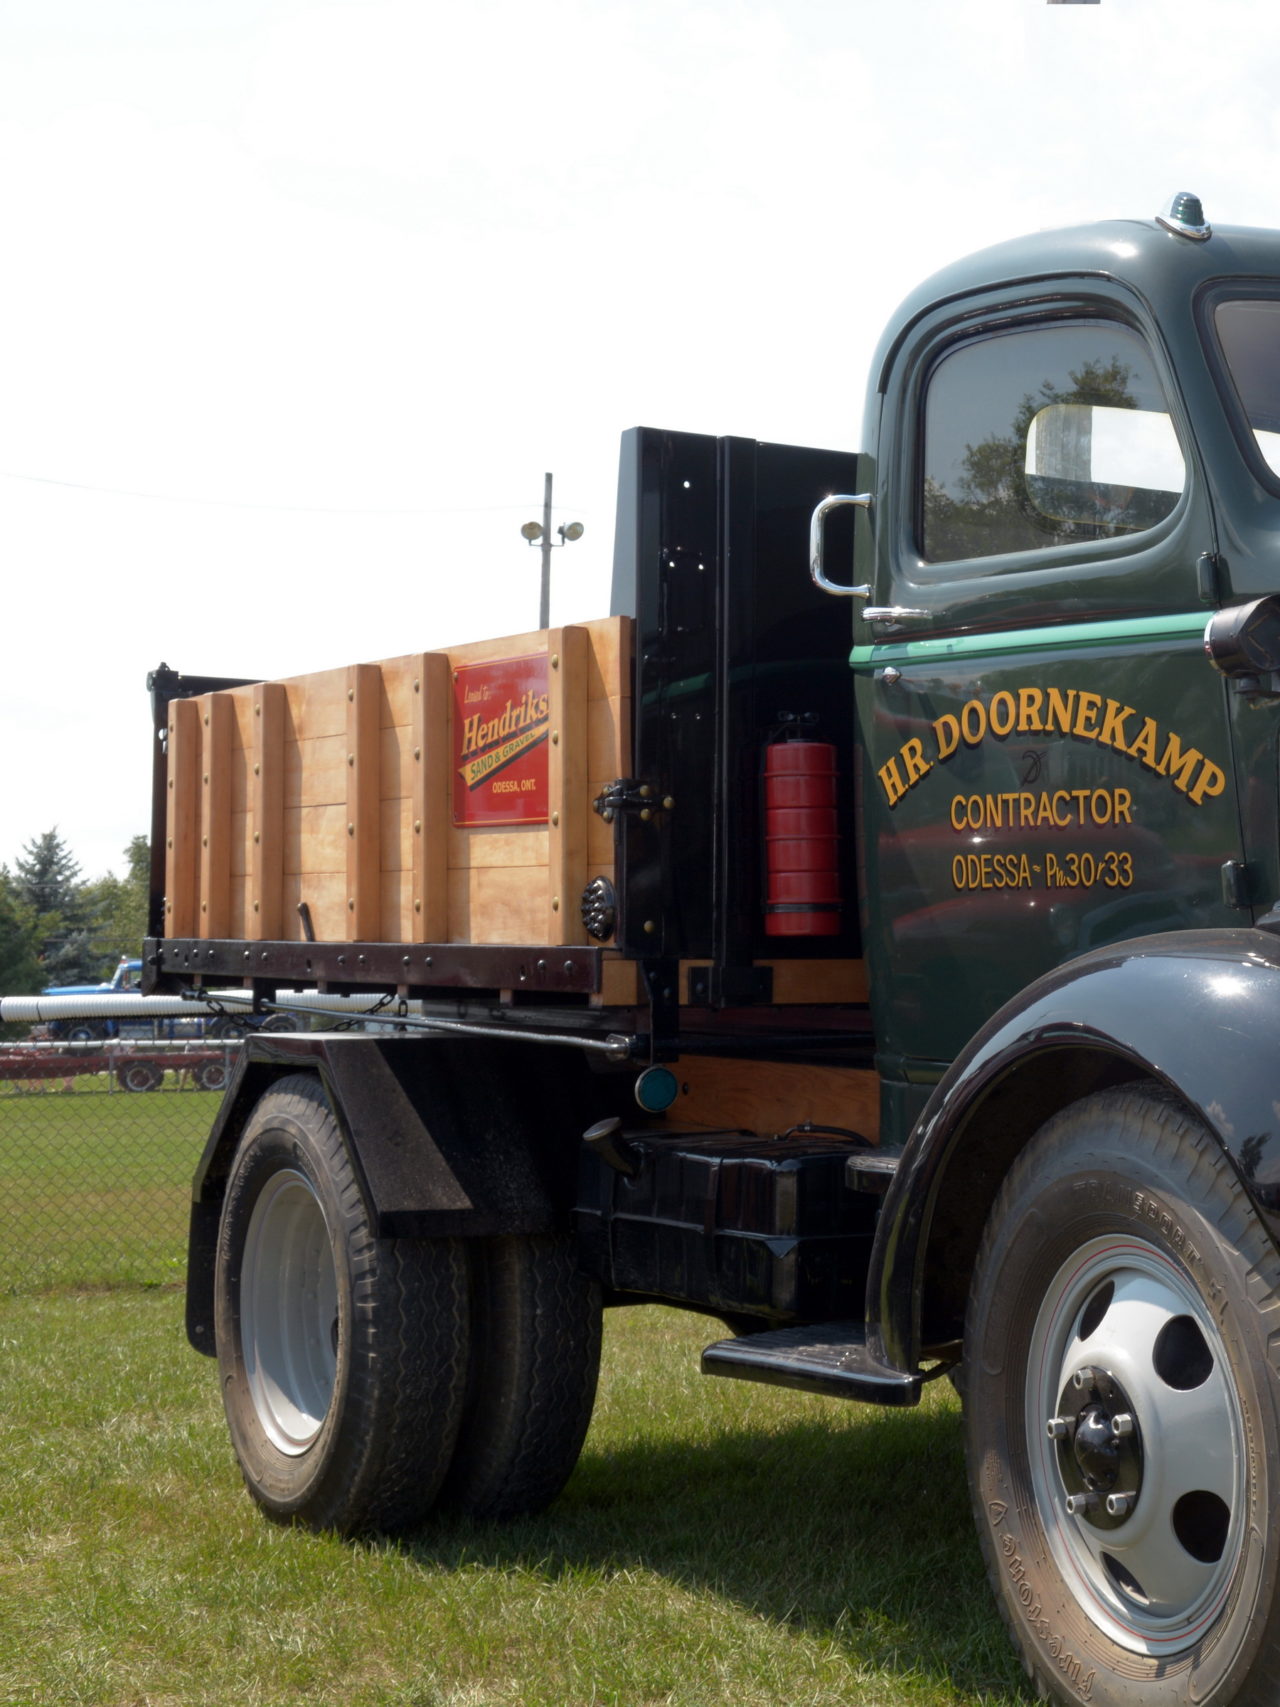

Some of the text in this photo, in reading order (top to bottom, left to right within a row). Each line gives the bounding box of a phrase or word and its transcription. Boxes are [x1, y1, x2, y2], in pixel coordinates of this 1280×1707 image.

[470, 755, 496, 781] SAND
[502, 732, 536, 758] GRAVEL
[932, 687, 1225, 806] DOORNEKAMP
[950, 788, 1132, 831] CONTRACTOR
[952, 853, 1032, 889] ODESSA
